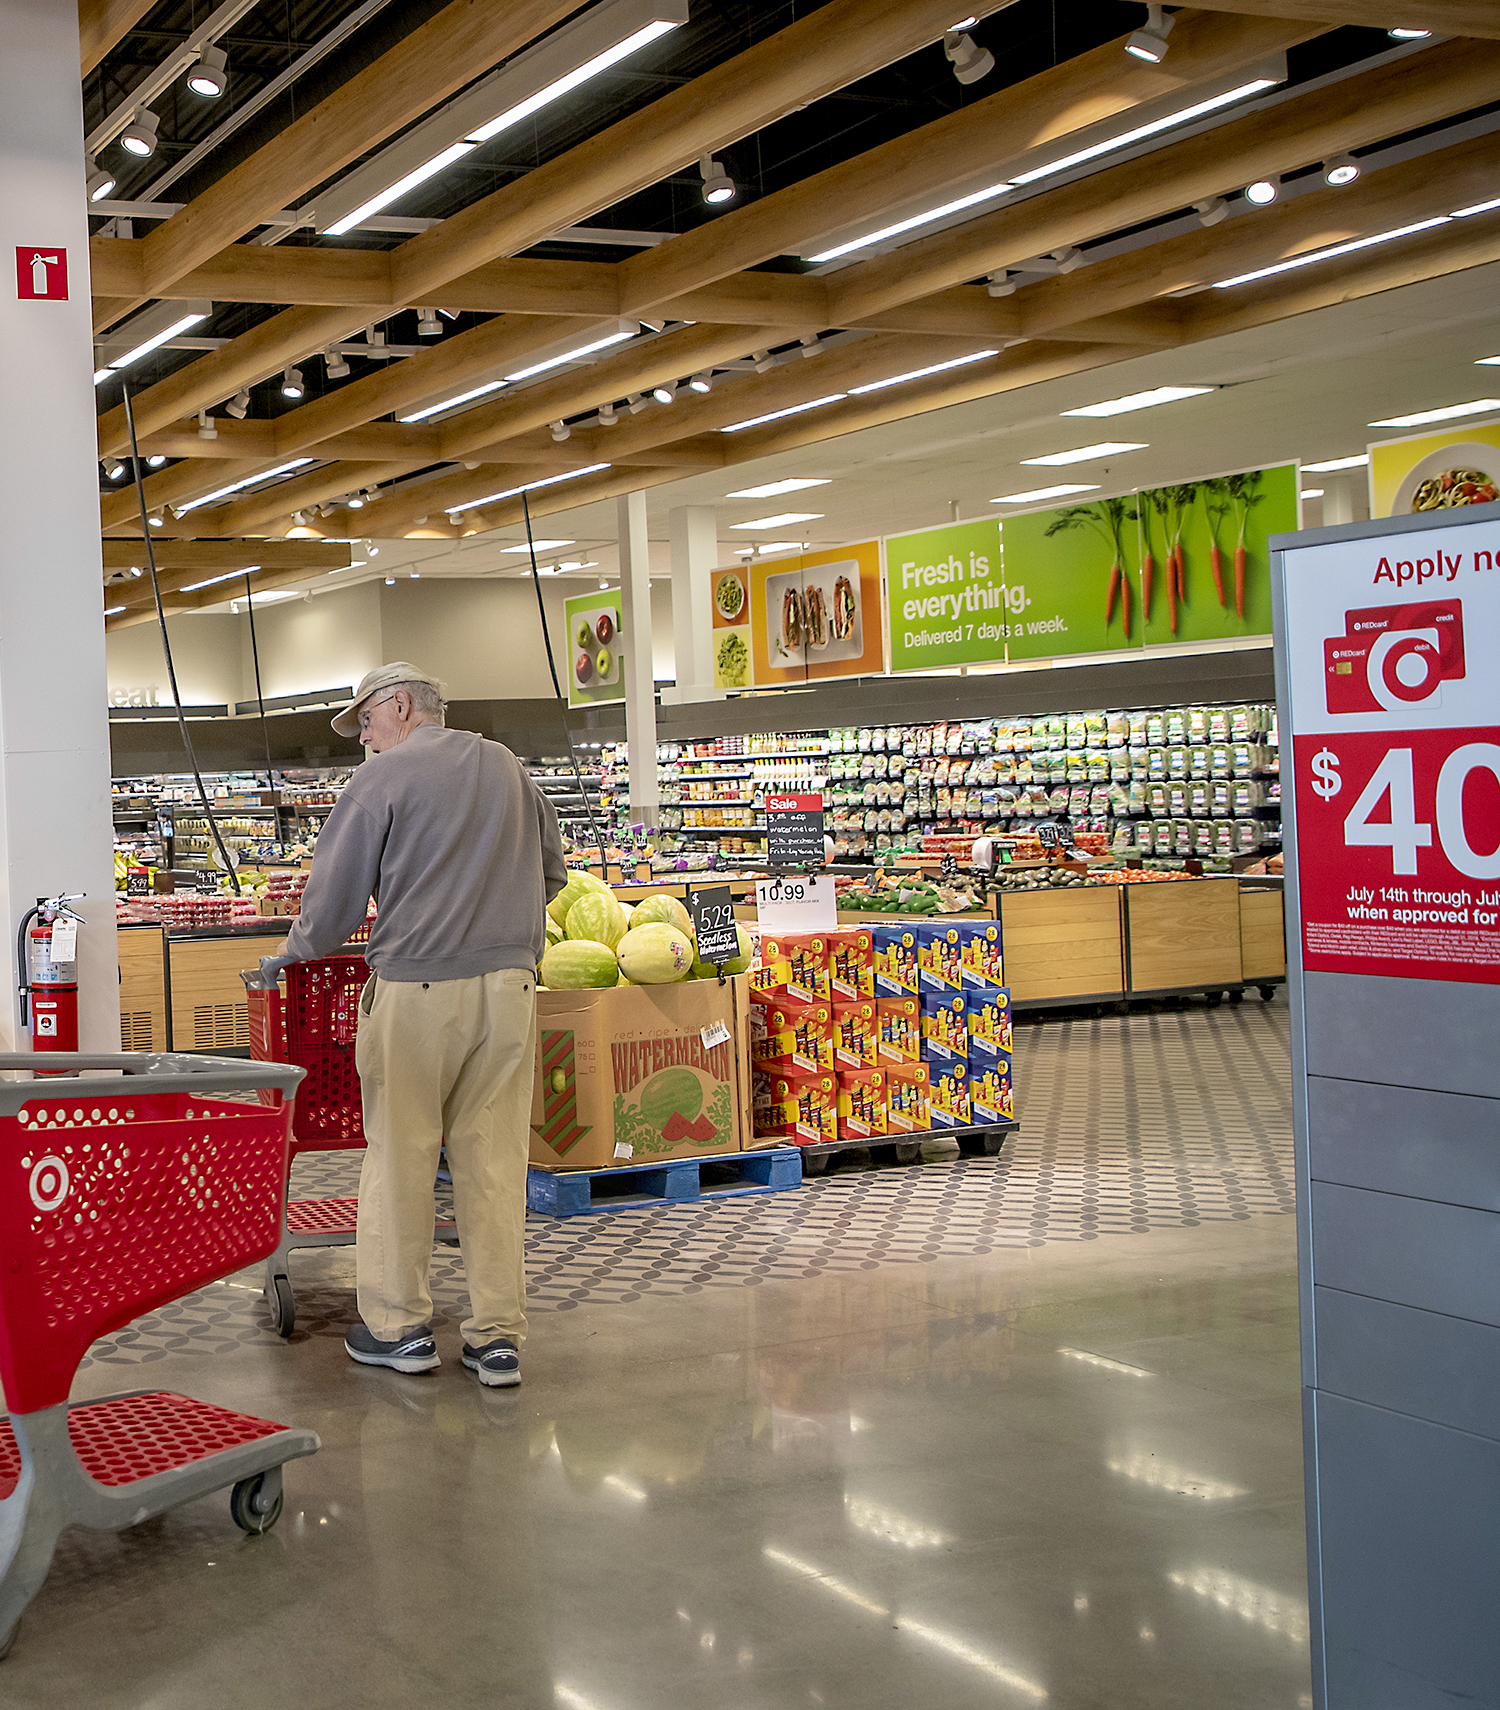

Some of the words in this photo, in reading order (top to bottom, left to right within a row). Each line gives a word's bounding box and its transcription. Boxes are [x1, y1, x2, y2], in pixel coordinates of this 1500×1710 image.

[902, 555, 963, 590] Fresh
[969, 551, 990, 579] is
[1373, 550, 1462, 587] Apply
[903, 580, 1032, 621] everything.
[1361, 620, 1388, 629] REDcard
[1436, 614, 1454, 622] credit
[904, 625, 962, 648] Delivered
[965, 624, 974, 640] 7
[977, 622, 1011, 641] days
[1014, 623, 1024, 637] a
[1027, 615, 1069, 635] week.
[1340, 649, 1366, 658] REDcard
[109, 684, 160, 707] eat
[770, 798, 797, 810] Sale
[770, 825, 818, 834] watermelon
[691, 892, 700, 906] $
[759, 884, 805, 901] 10.99
[1346, 886, 1375, 904] July
[1379, 887, 1408, 903] 14th
[1412, 888, 1471, 907] through
[1475, 890, 1500, 906] Jul
[700, 904, 732, 932] 5.29
[1347, 906, 1389, 920] when
[1392, 909, 1469, 925] approved
[1472, 909, 1498, 925] for
[697, 932, 733, 947] Seedless
[699, 941, 737, 956] Watermelon
[614, 1029, 634, 1040] red
[648, 1026, 670, 1038] ripe
[611, 1034, 731, 1093] WATERMELON
